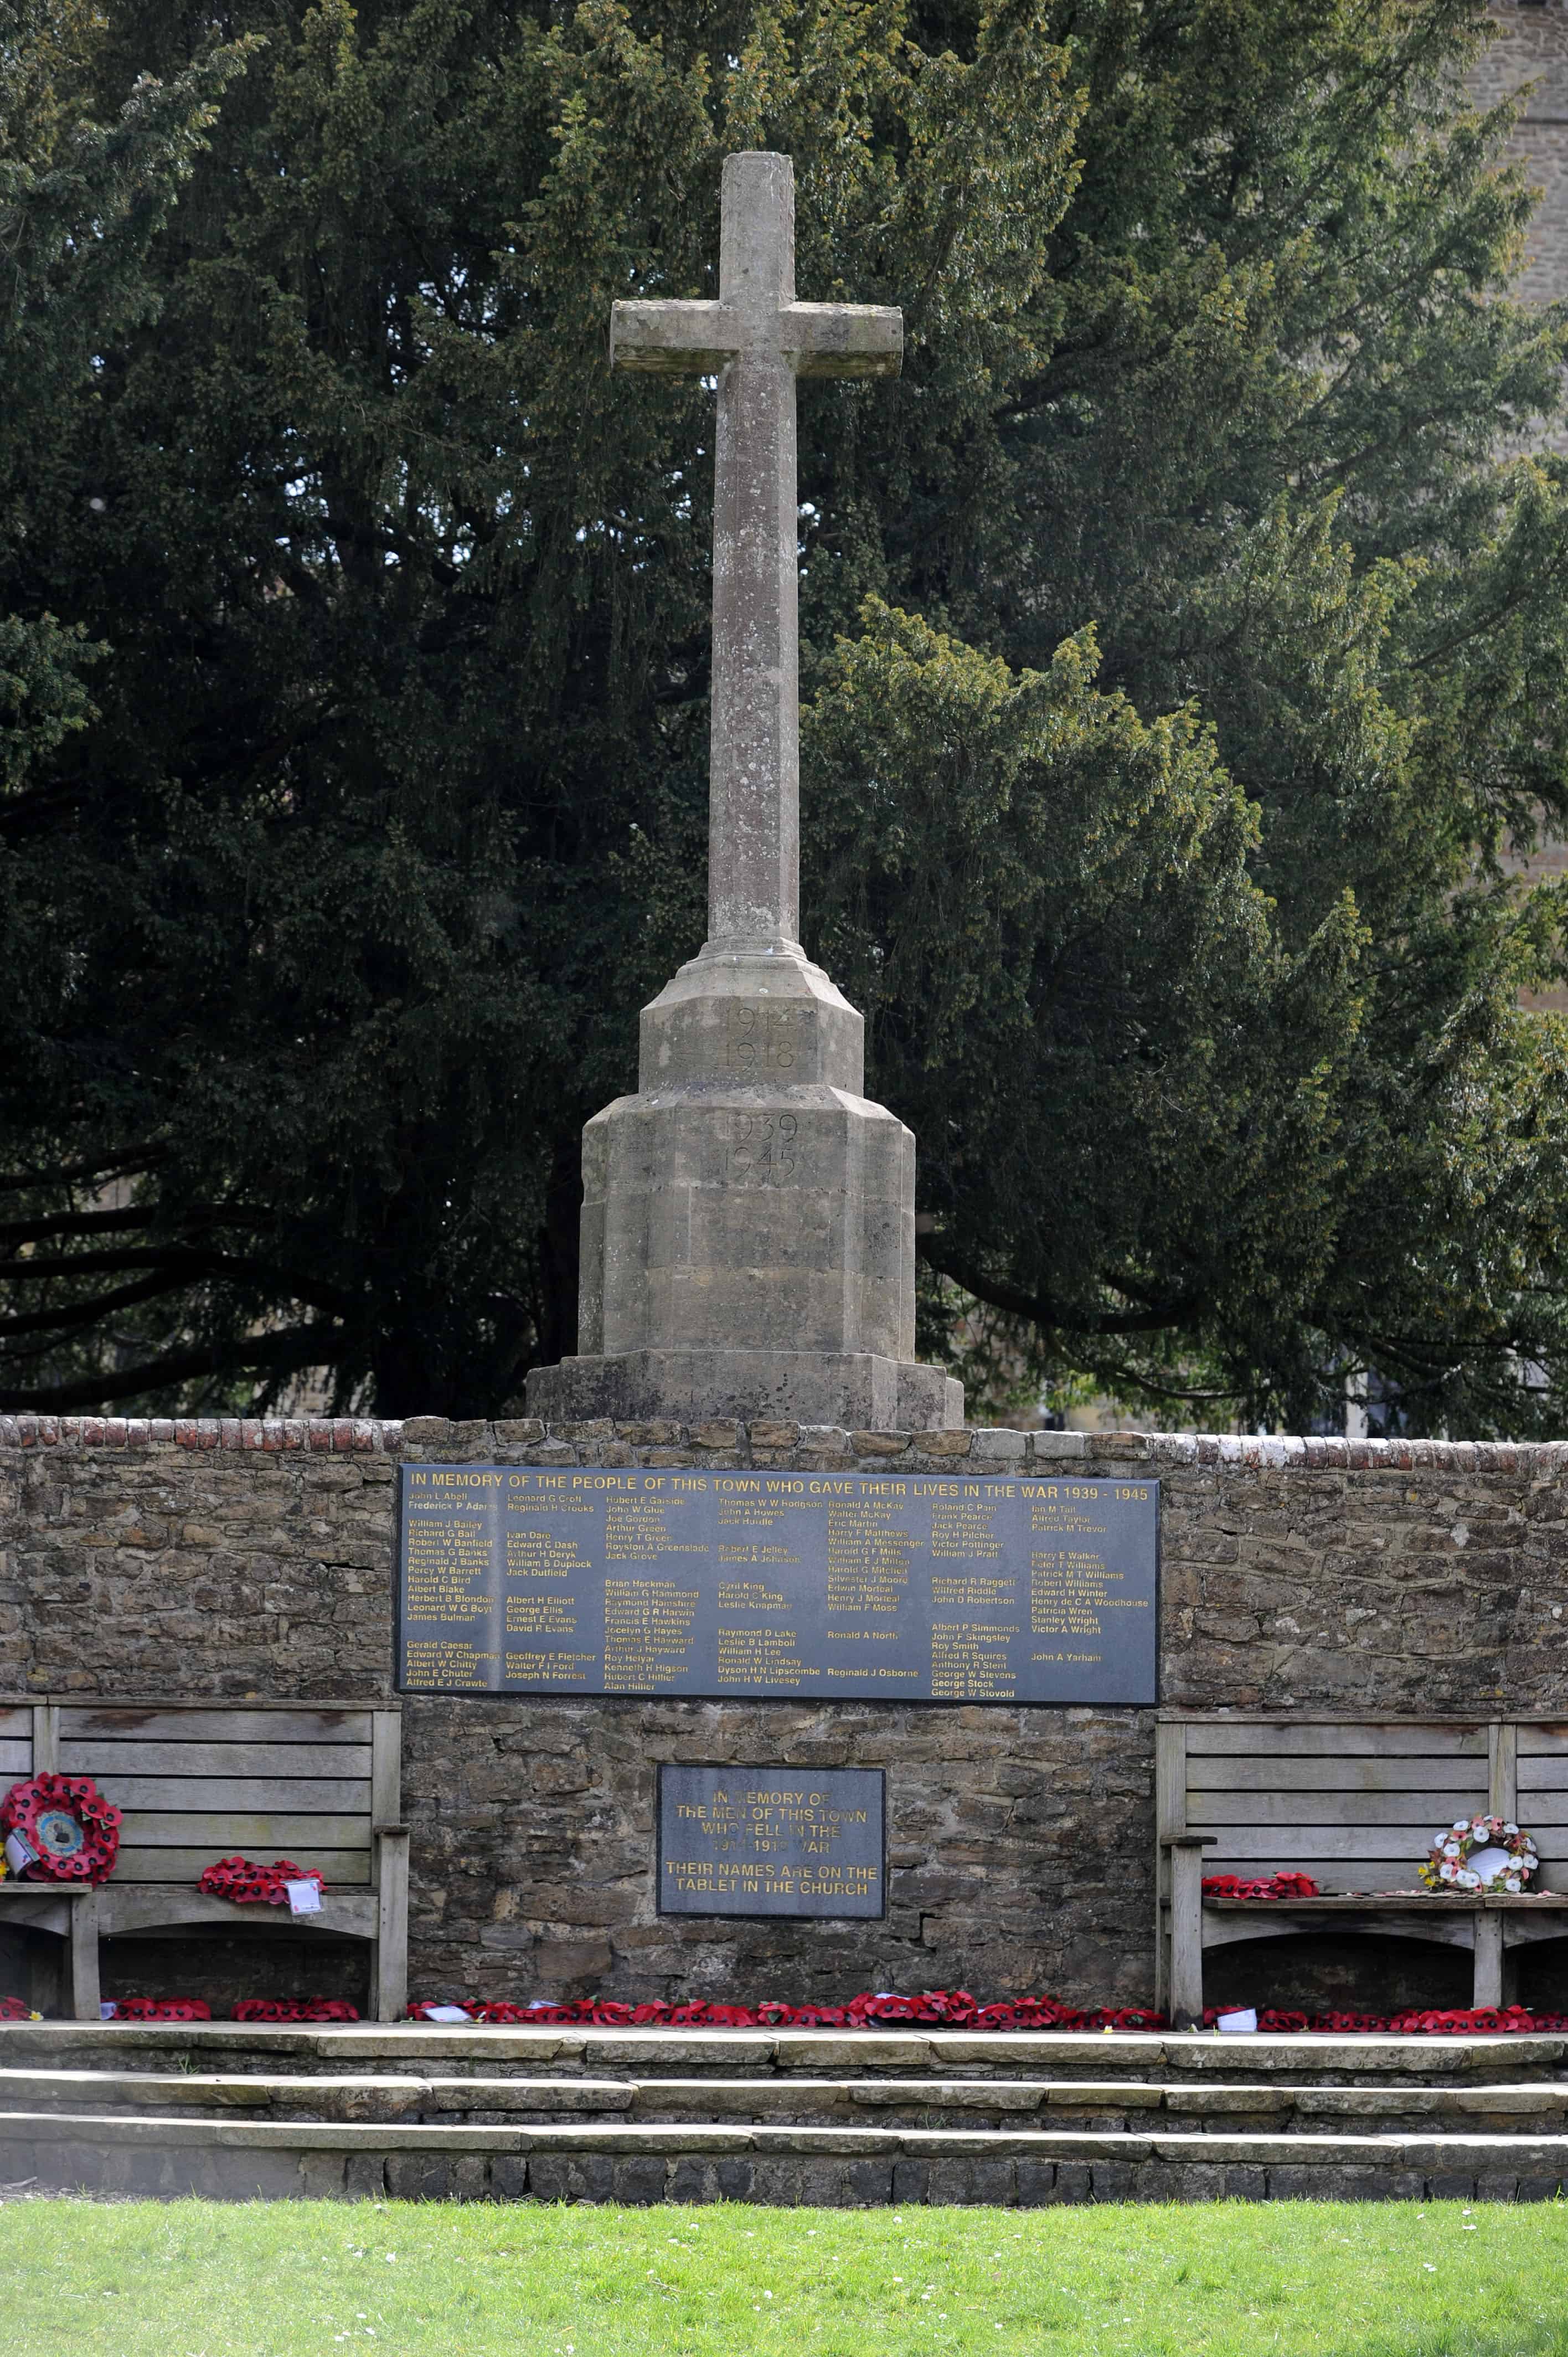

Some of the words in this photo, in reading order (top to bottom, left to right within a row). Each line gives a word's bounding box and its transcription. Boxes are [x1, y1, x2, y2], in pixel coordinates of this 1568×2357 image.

[725, 1007, 796, 1037] 1914
[725, 1041, 795, 1072] 1918
[726, 1113, 798, 1143] 1939
[725, 1147, 795, 1176] 1945
[411, 1474, 426, 1485] IN
[432, 1473, 503, 1487] MEMORY
[509, 1475, 530, 1487] OF
[536, 1475, 567, 1488] THE
[572, 1476, 637, 1490] PEOPLE
[644, 1478, 666, 1490] OF
[672, 1478, 707, 1491] THIS
[713, 1479, 760, 1493] TOWN
[767, 1480, 804, 1493] WHO
[809, 1481, 854, 1494] GAVE
[859, 1483, 906, 1495] THEIR
[914, 1484, 958, 1496] LIVES
[964, 1485, 979, 1497] IN
[984, 1485, 1015, 1497] THE
[1022, 1486, 1058, 1498] WAR
[1063, 1488, 1098, 1499] 1939
[1115, 1489, 1148, 1500] 1945
[860, 1511, 891, 1520] McKay
[453, 1520, 483, 1530] Bailey
[956, 1522, 988, 1530] Pearce
[931, 1530, 951, 1539] Roy
[458, 1548, 488, 1556] Banks
[408, 1557, 450, 1567] Reginald
[460, 1558, 489, 1566] Banks
[507, 1606, 541, 1615] George
[651, 1617, 690, 1625] Hawkins
[1031, 1616, 1066, 1625] Stanley
[1068, 1617, 1099, 1626] Wright
[971, 1624, 1020, 1632] Simmonds
[1070, 1625, 1101, 1635] Wright
[718, 1629, 763, 1638] Raymond
[932, 1641, 950, 1650] Roy
[604, 1654, 623, 1663] Roy
[506, 1671, 540, 1680] Joseph
[718, 1666, 749, 1675] Dyson
[770, 1667, 822, 1677] Lipscombe
[828, 1669, 869, 1678] Reginald
[879, 1669, 919, 1677] Osborne
[765, 1676, 801, 1686] Livesey
[932, 1679, 966, 1689] George
[713, 1790, 728, 1803] IN
[809, 1793, 831, 1805] OF
[677, 1805, 707, 1818] THE
[713, 1807, 747, 1819] MEN
[752, 1808, 773, 1820] OF
[779, 1808, 814, 1821] THIS
[819, 1809, 867, 1823] TOWN
[702, 1822, 739, 1834] WHO
[745, 1824, 783, 1836] FELL
[789, 1824, 804, 1836] IN
[809, 1825, 842, 1838] THE
[666, 1861, 713, 1875] THEIR
[719, 1863, 775, 1877] NAMES
[781, 1865, 813, 1878] ARE
[819, 1866, 841, 1879] ON
[847, 1867, 878, 1880] THE
[677, 1878, 737, 1892] TABLET
[744, 1880, 758, 1892] IN
[764, 1880, 794, 1893] THE
[800, 1881, 868, 1895] CHURCH
